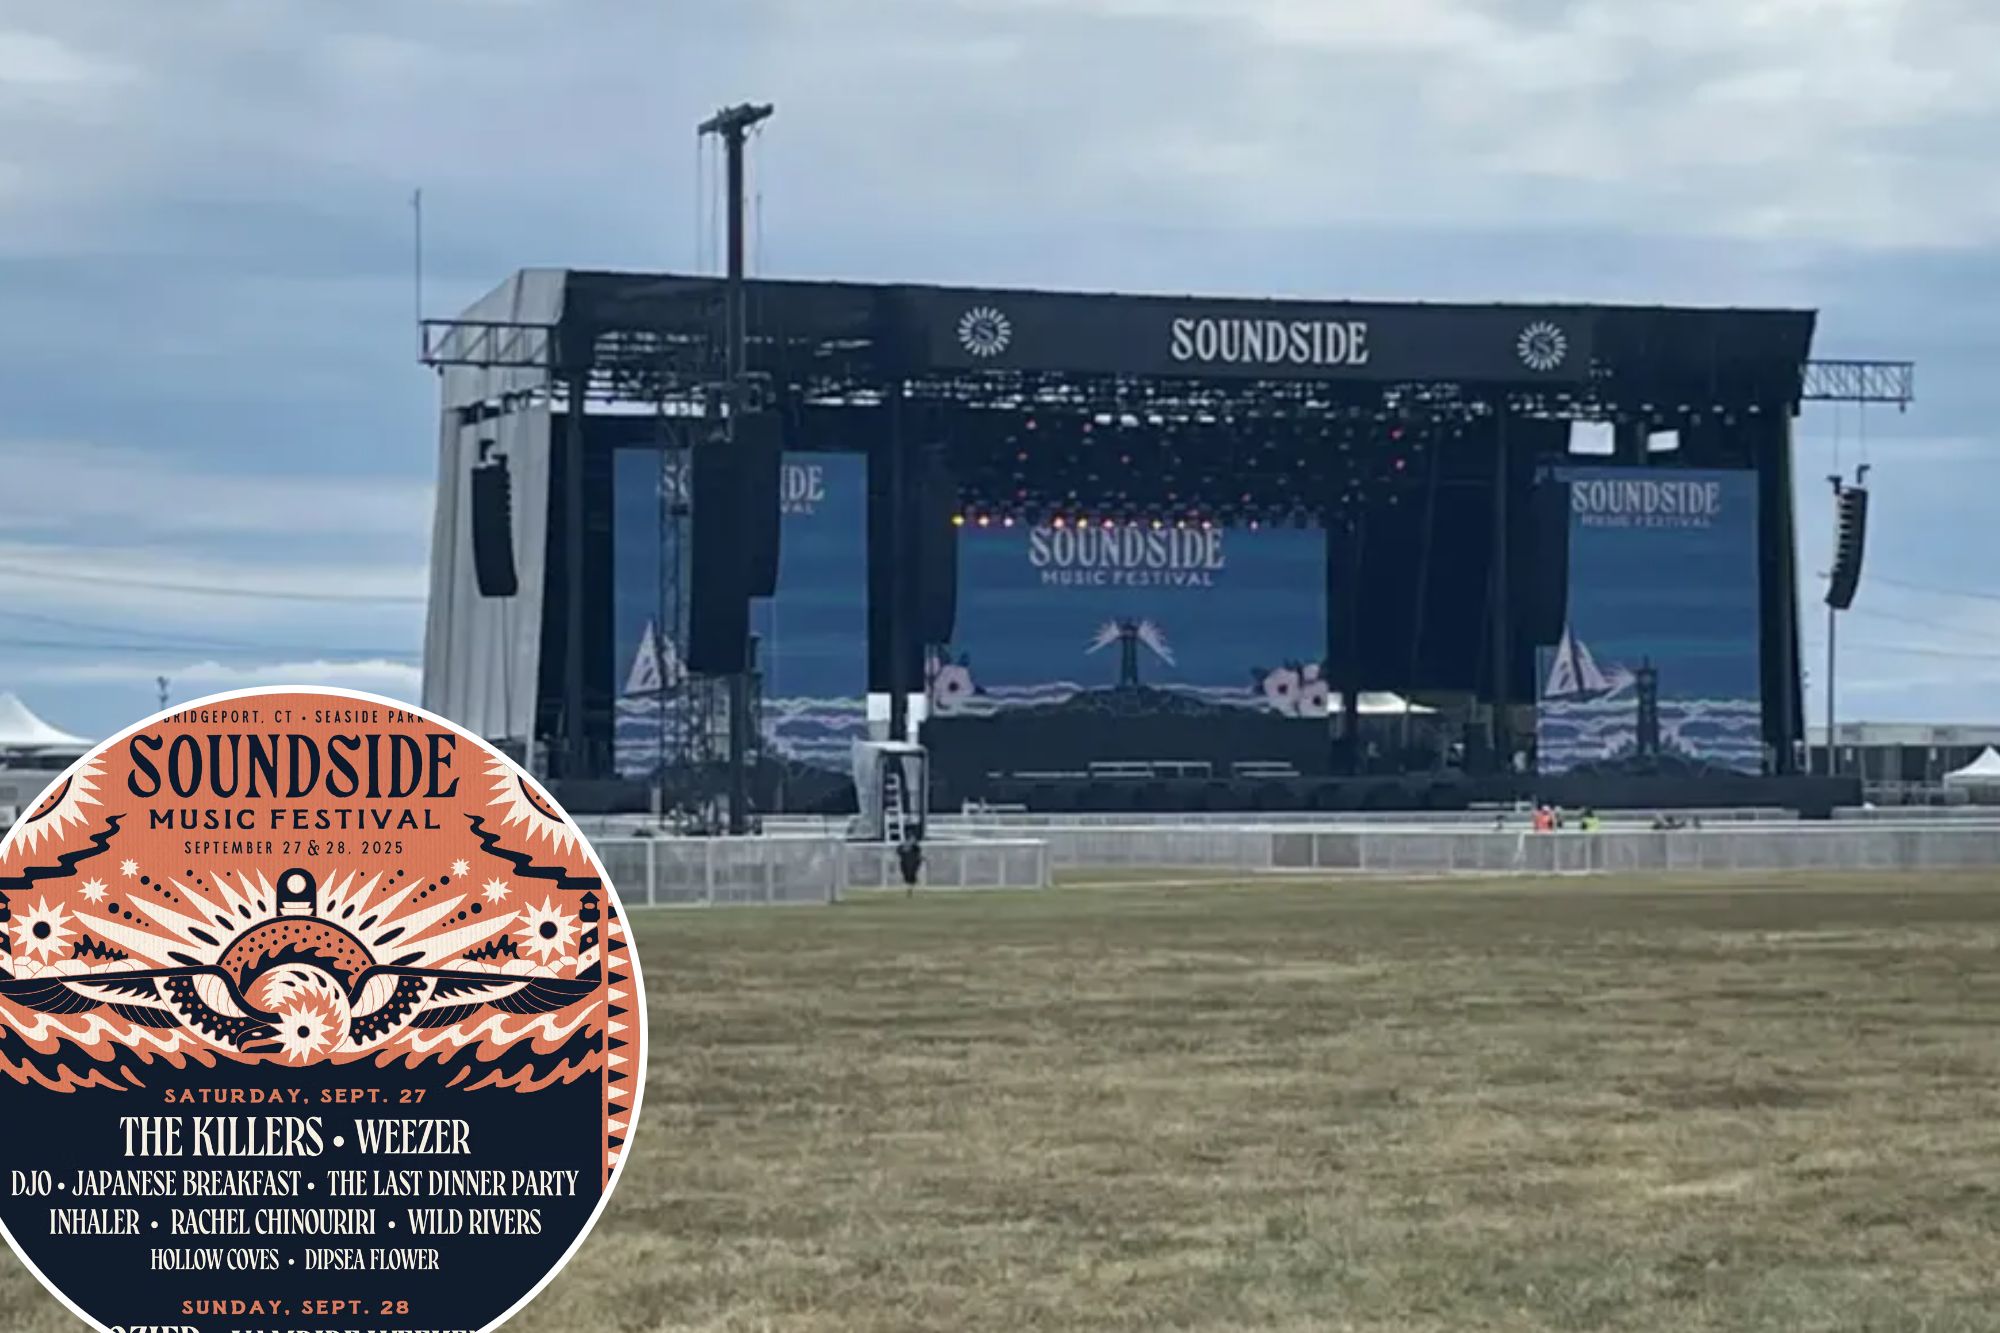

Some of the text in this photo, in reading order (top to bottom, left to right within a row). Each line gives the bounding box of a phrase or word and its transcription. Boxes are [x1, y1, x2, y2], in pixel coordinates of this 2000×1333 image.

[1171, 317, 1369, 365] SOUNDSIDE
[1571, 480, 1721, 514] SOUNDSIDE
[1029, 526, 1225, 569] SOUNDSIDE
[1041, 570, 1214, 587] MUSIC FESTIVAL
